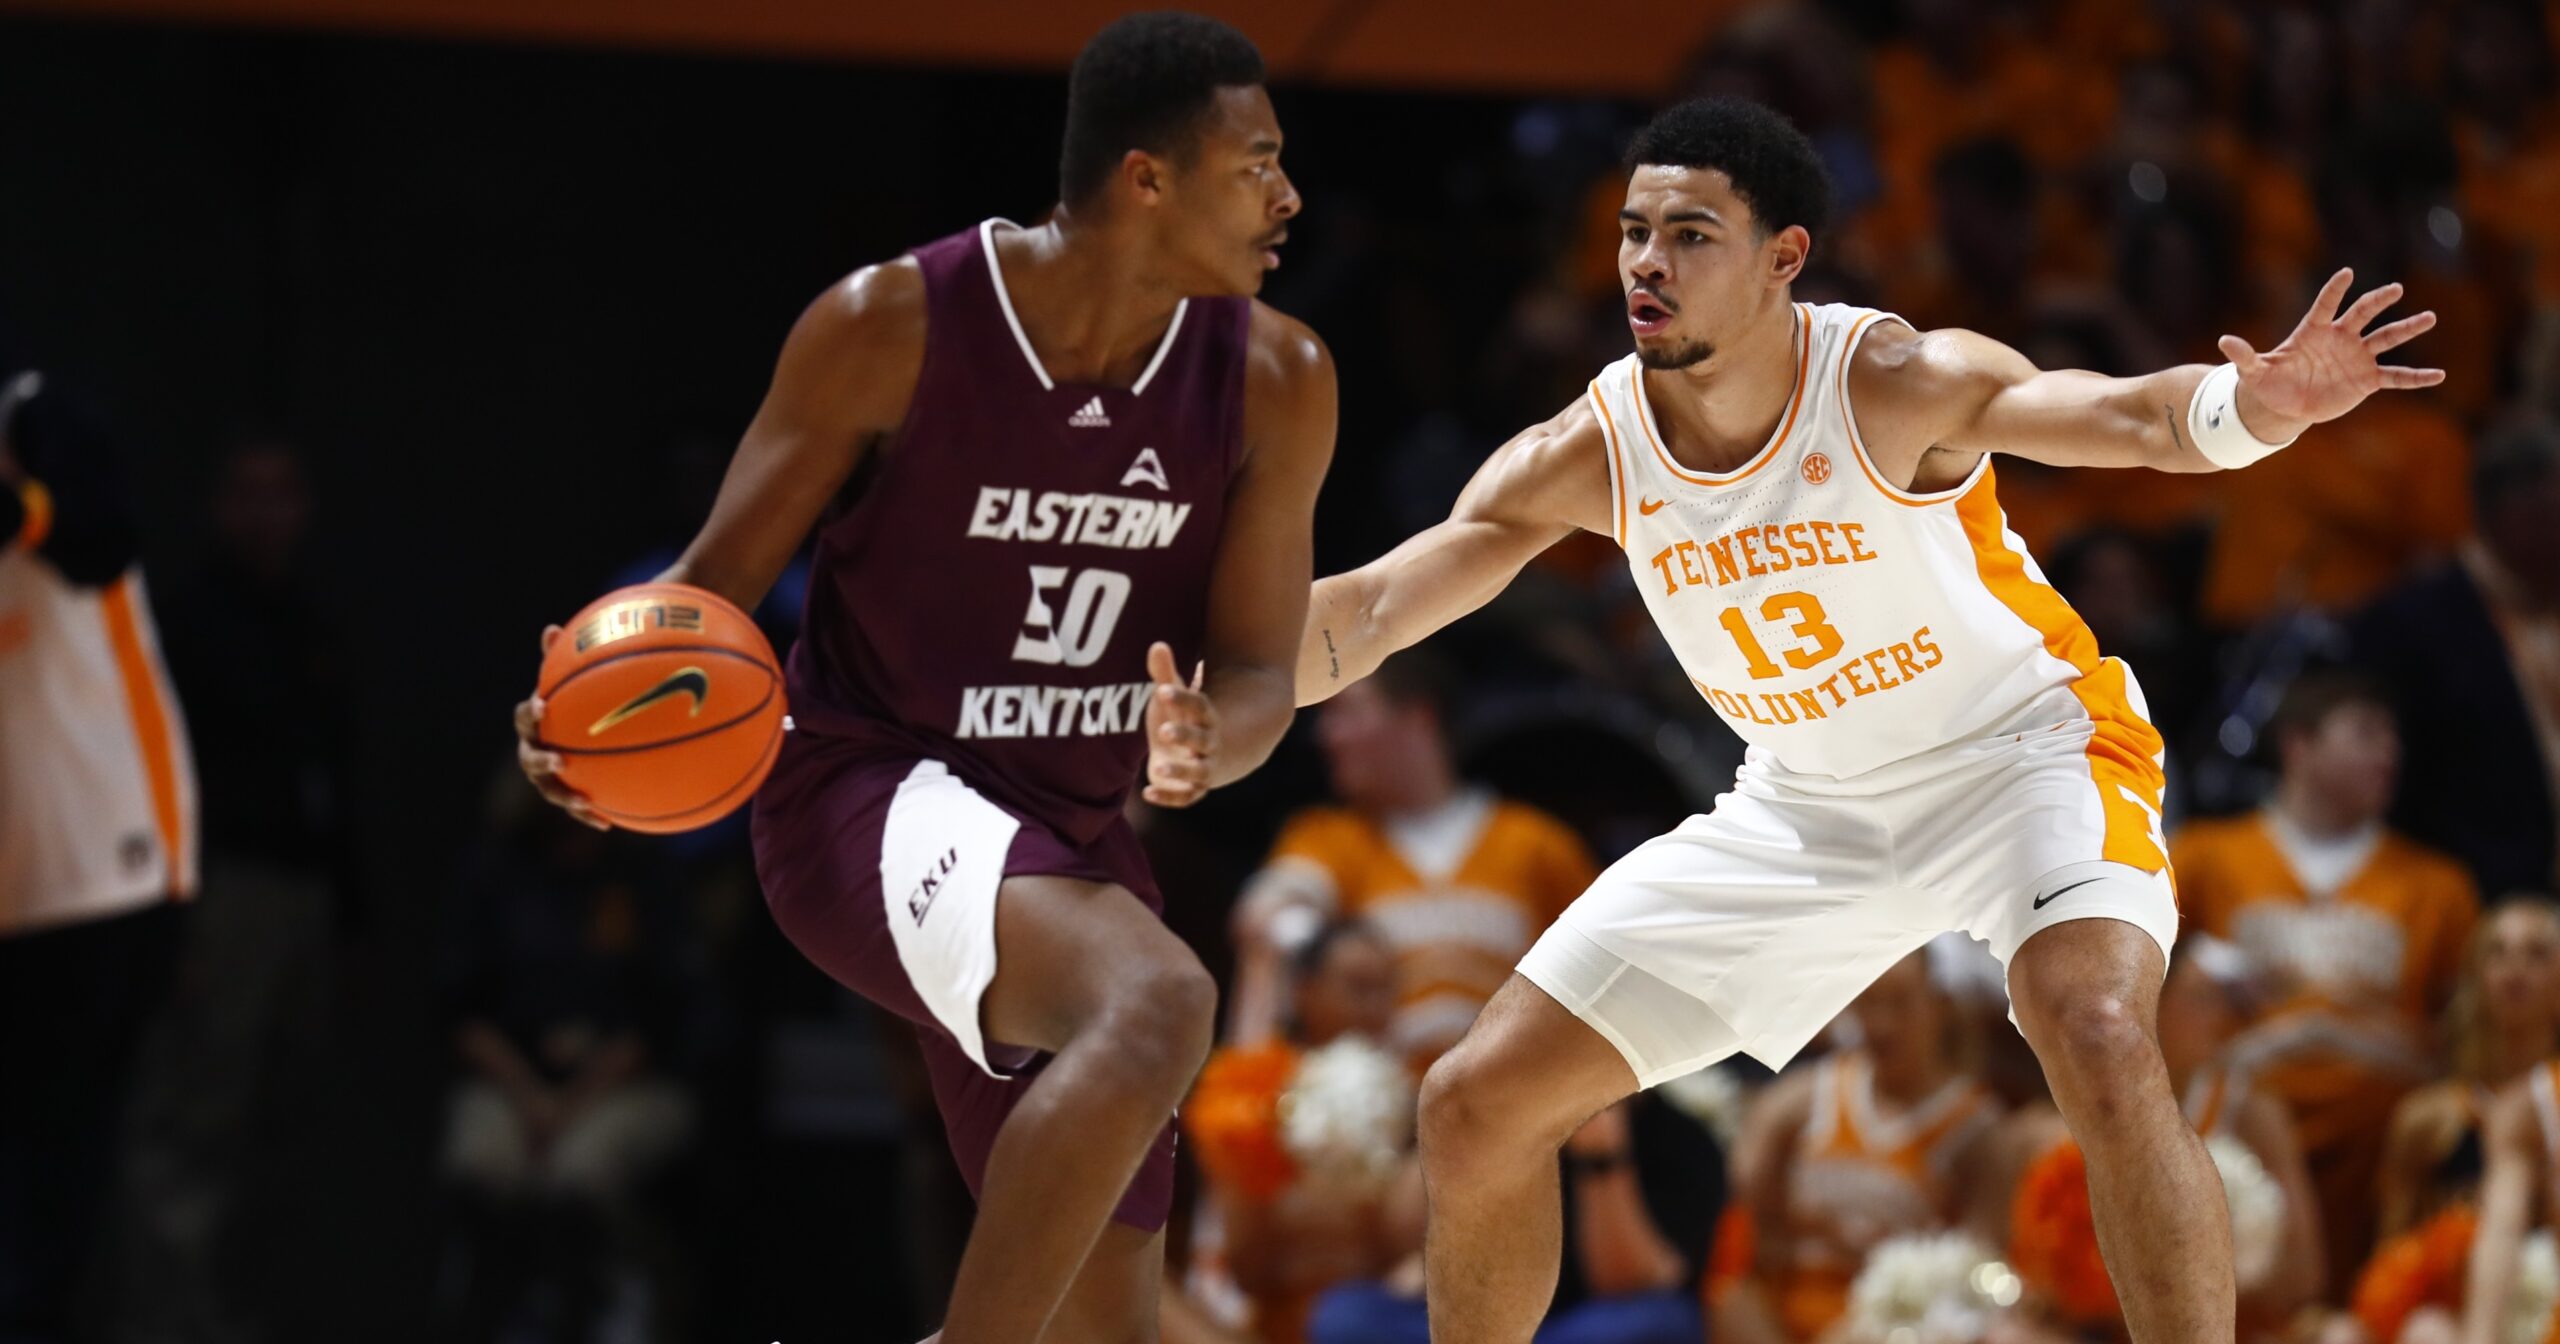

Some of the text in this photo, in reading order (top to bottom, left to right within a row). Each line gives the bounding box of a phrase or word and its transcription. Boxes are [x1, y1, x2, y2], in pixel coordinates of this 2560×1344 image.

[1803, 454, 1829, 482] SEC
[966, 485, 1192, 549] EASTERN
[1651, 520, 1878, 597] TENESSEE
[1011, 565, 1132, 668] 50
[1718, 590, 1844, 680] 13
[954, 681, 1157, 738] KENTCKY
